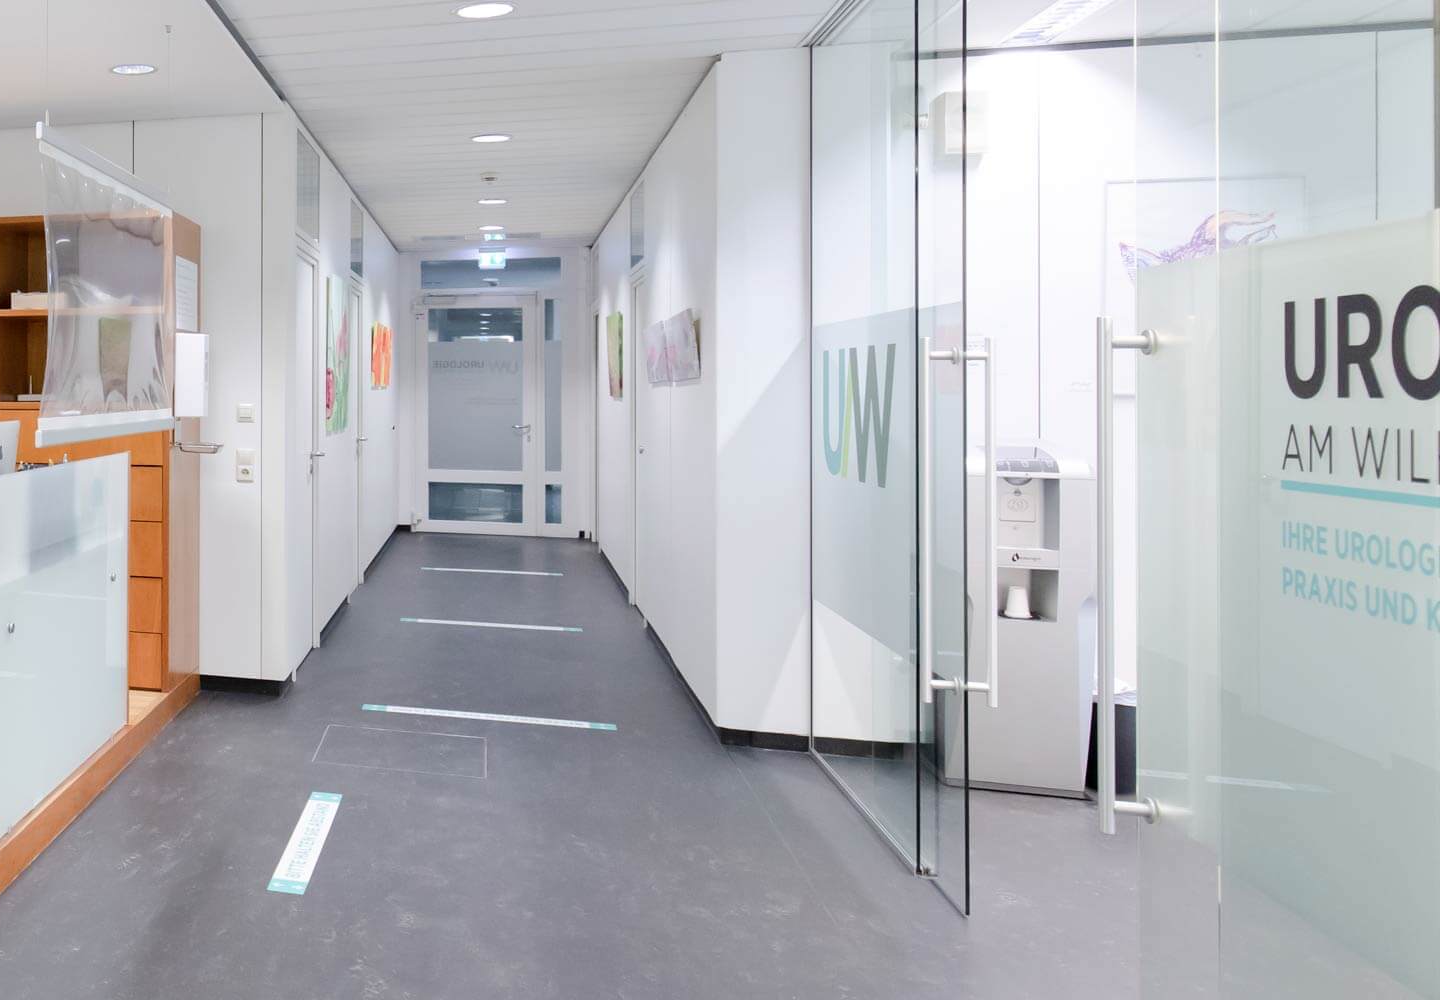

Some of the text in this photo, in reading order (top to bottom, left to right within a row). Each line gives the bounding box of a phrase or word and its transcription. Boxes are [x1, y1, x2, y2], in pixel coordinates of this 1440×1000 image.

[1284, 285, 1440, 400] URO
[1282, 424, 1440, 485] AM WIL
[1282, 520, 1328, 555] IHRE
[1282, 566, 1358, 611] PRAXIS
[1365, 584, 1417, 625] UND
